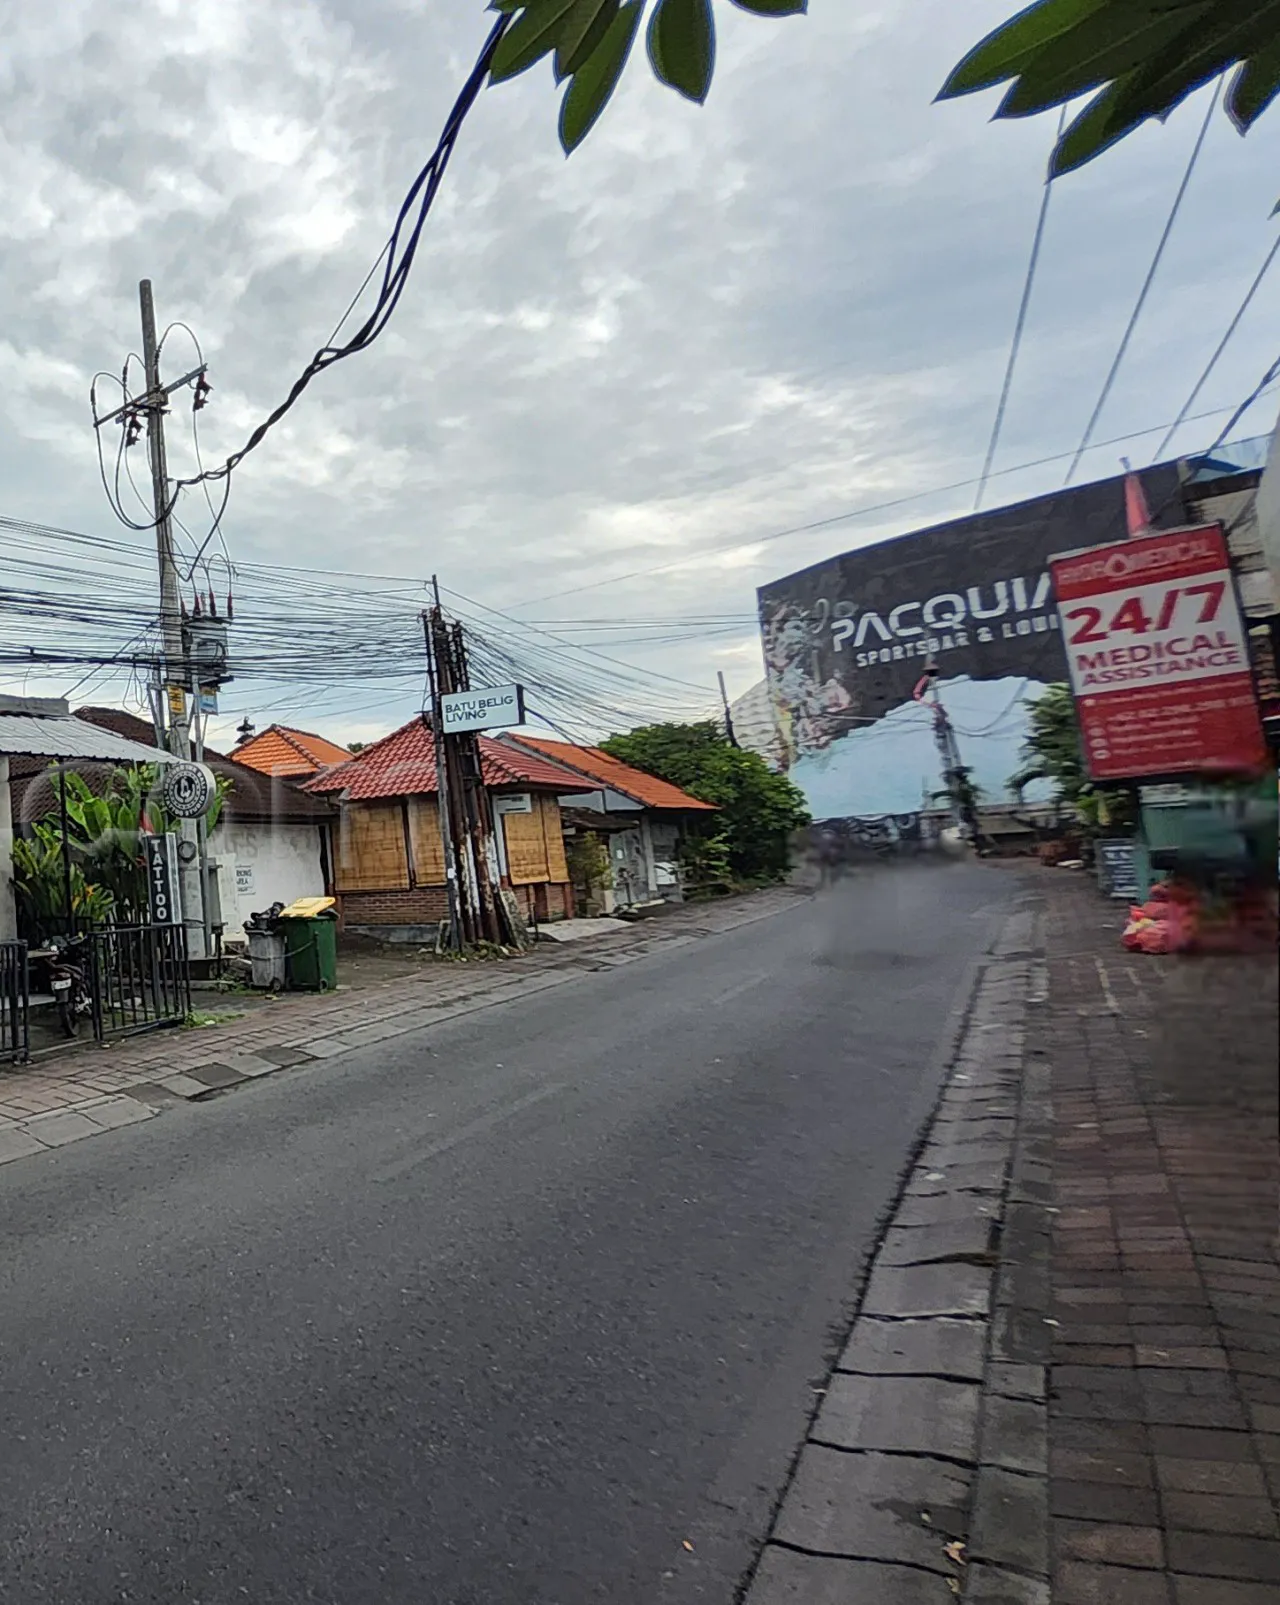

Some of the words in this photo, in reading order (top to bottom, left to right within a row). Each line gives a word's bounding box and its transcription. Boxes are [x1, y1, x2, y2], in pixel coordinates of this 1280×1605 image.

[1064, 580, 1227, 645] 24/7
[856, 631, 970, 667] SPORTSBAR
[976, 626, 994, 642] &
[1074, 630, 1239, 672] MEDICAL
[1081, 650, 1243, 688] ASSISTANCE
[444, 699, 476, 714] BATU
[478, 695, 514, 709] BELIG
[445, 709, 487, 723] LIVING
[150, 839, 167, 920] TATTOO
